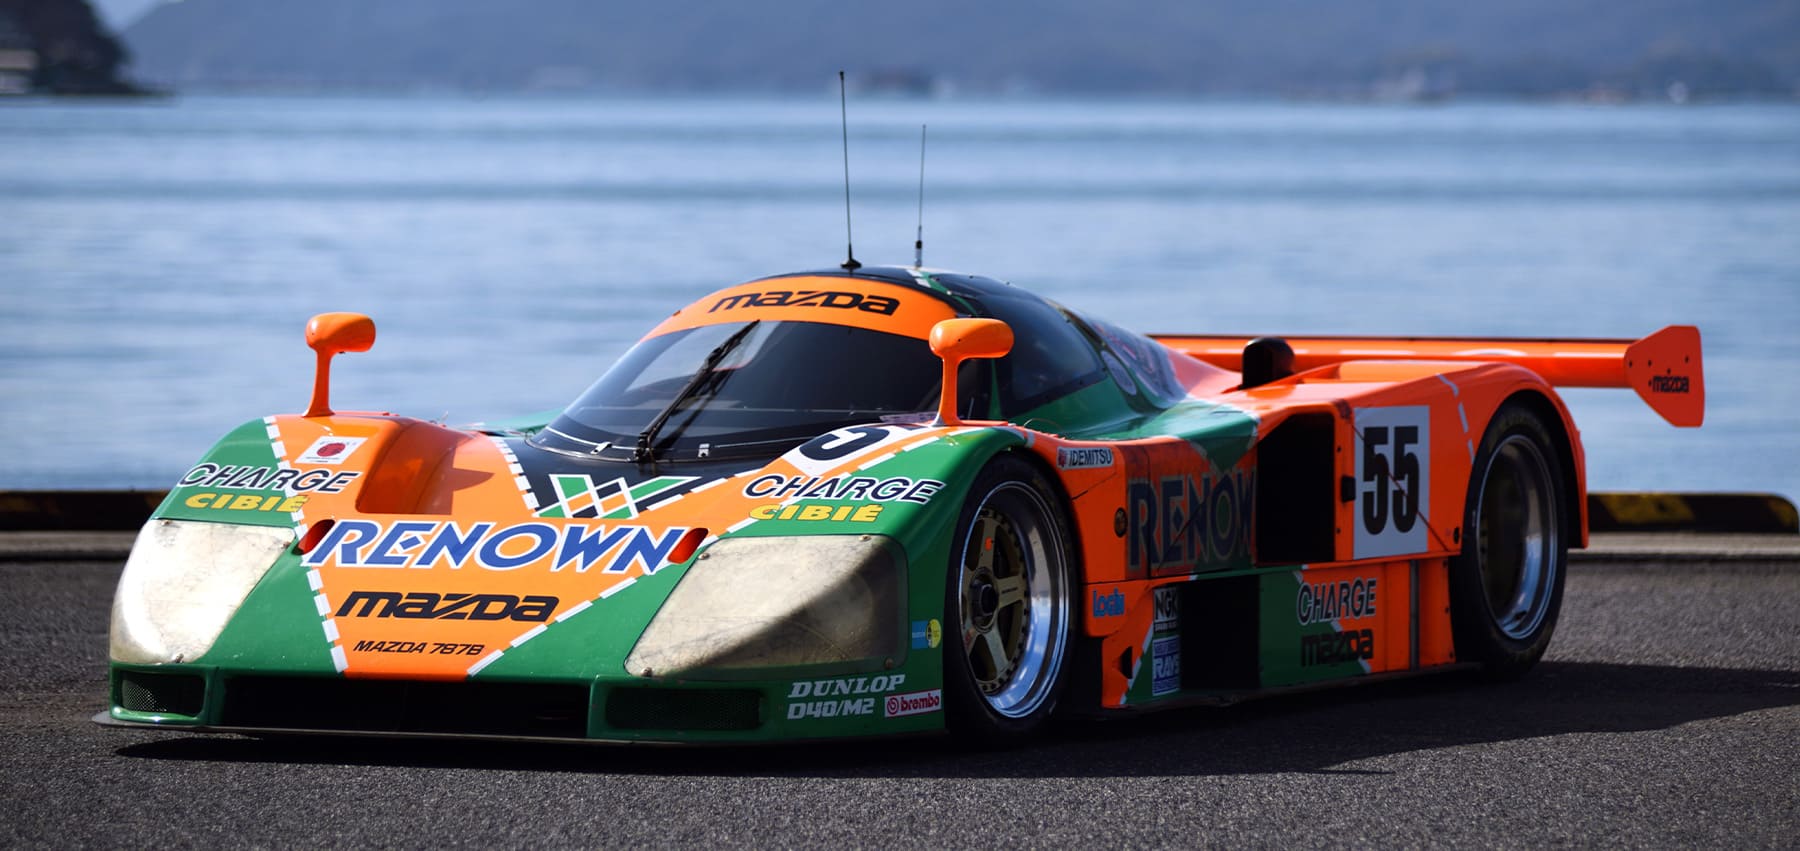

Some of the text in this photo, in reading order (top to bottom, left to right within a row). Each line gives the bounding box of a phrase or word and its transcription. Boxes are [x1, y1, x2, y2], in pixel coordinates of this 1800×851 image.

[1069, 448, 1113, 466] IDEMITSU
[178, 463, 362, 494] CHARGE
[743, 474, 946, 504] CHARGE
[1362, 426, 1419, 535] 55
[750, 504, 884, 522] CIBIÉ
[302, 519, 687, 574] RENOWN
[1297, 577, 1377, 626] CHARGE
[352, 640, 485, 655] MAZDA 787B
[787, 674, 906, 698] DUNLOP
[786, 698, 875, 720] D40/M2
[900, 692, 940, 711] brembo
